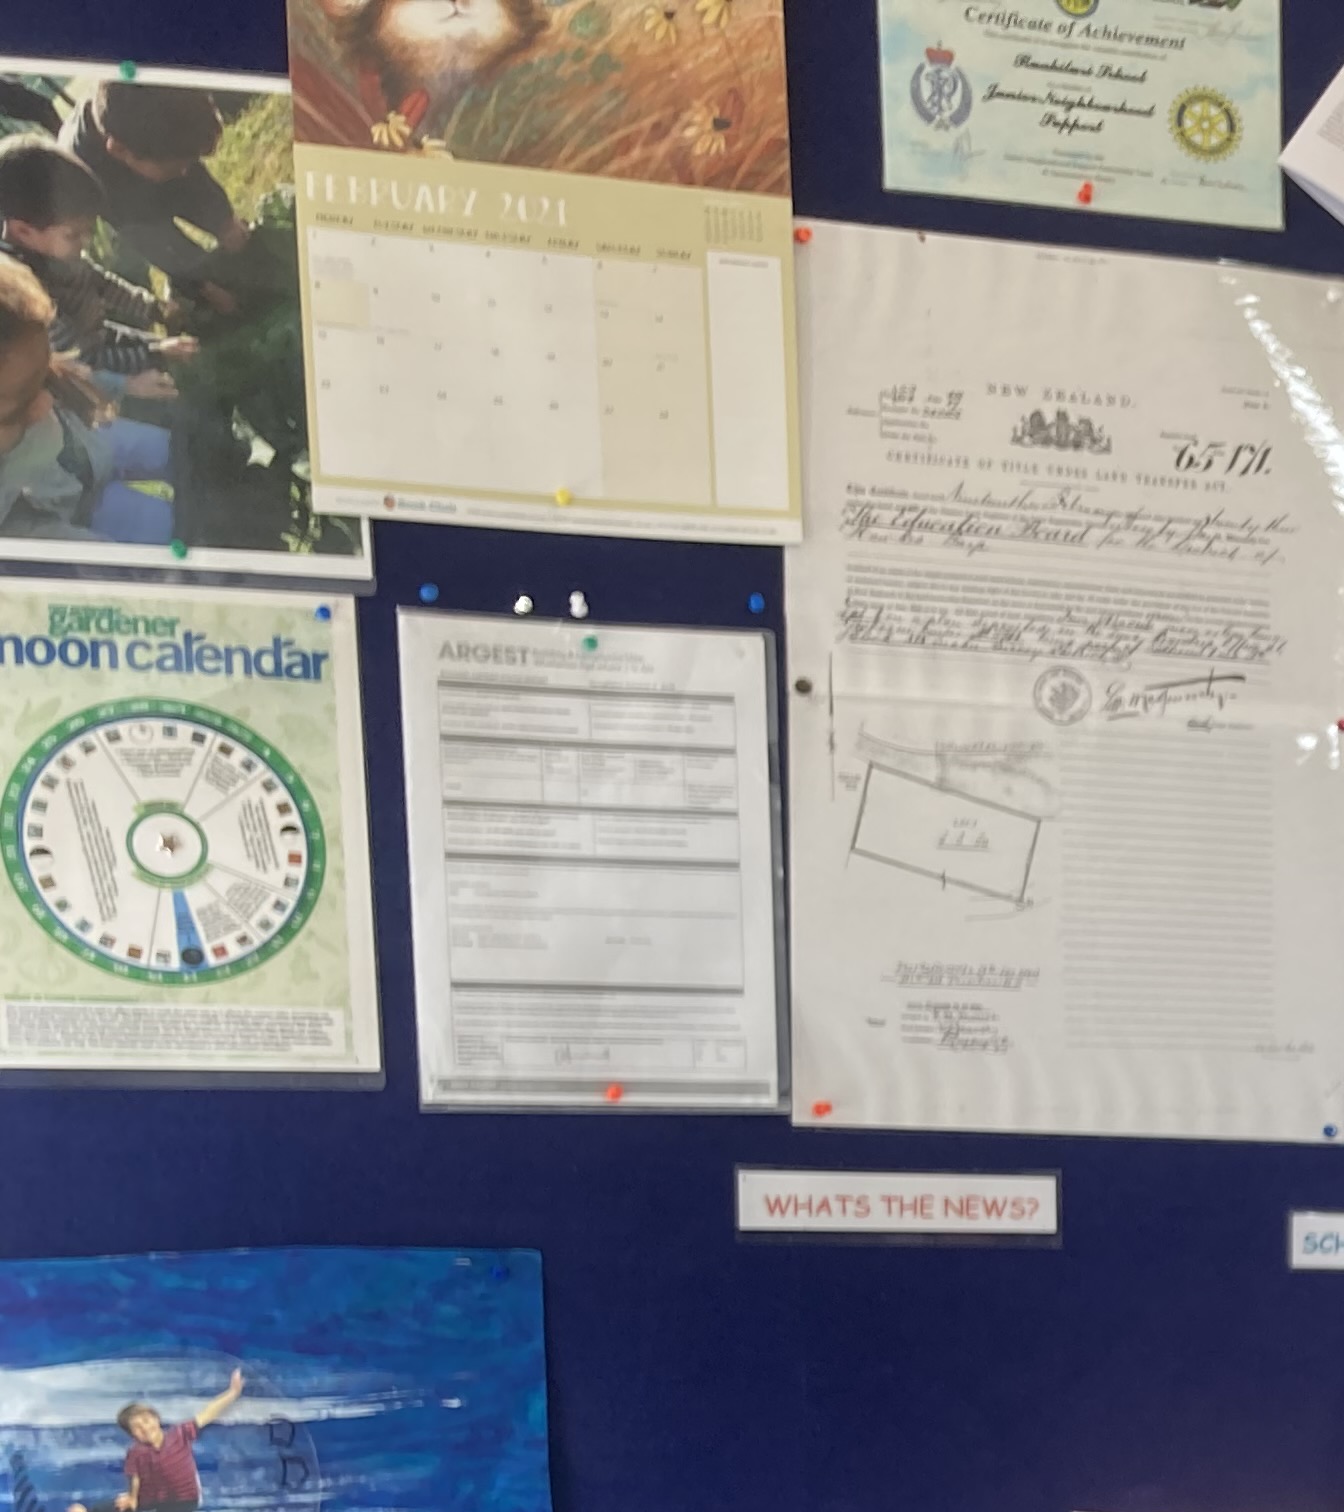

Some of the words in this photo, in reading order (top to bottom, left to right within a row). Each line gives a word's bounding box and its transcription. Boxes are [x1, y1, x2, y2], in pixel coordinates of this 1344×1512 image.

[964, 6, 1052, 31] Certificate
[1058, 20, 1076, 39] of
[1080, 22, 1186, 50] Achievement
[305, 171, 478, 217] FEBRUARY
[500, 191, 567, 228] 2021
[47, 604, 181, 639] gardener
[125, 630, 330, 683] calendar
[438, 640, 530, 665] ARGEST
[763, 1193, 871, 1218] WHATS
[879, 1195, 936, 1219] THE
[944, 1195, 1040, 1221] NEWS?
